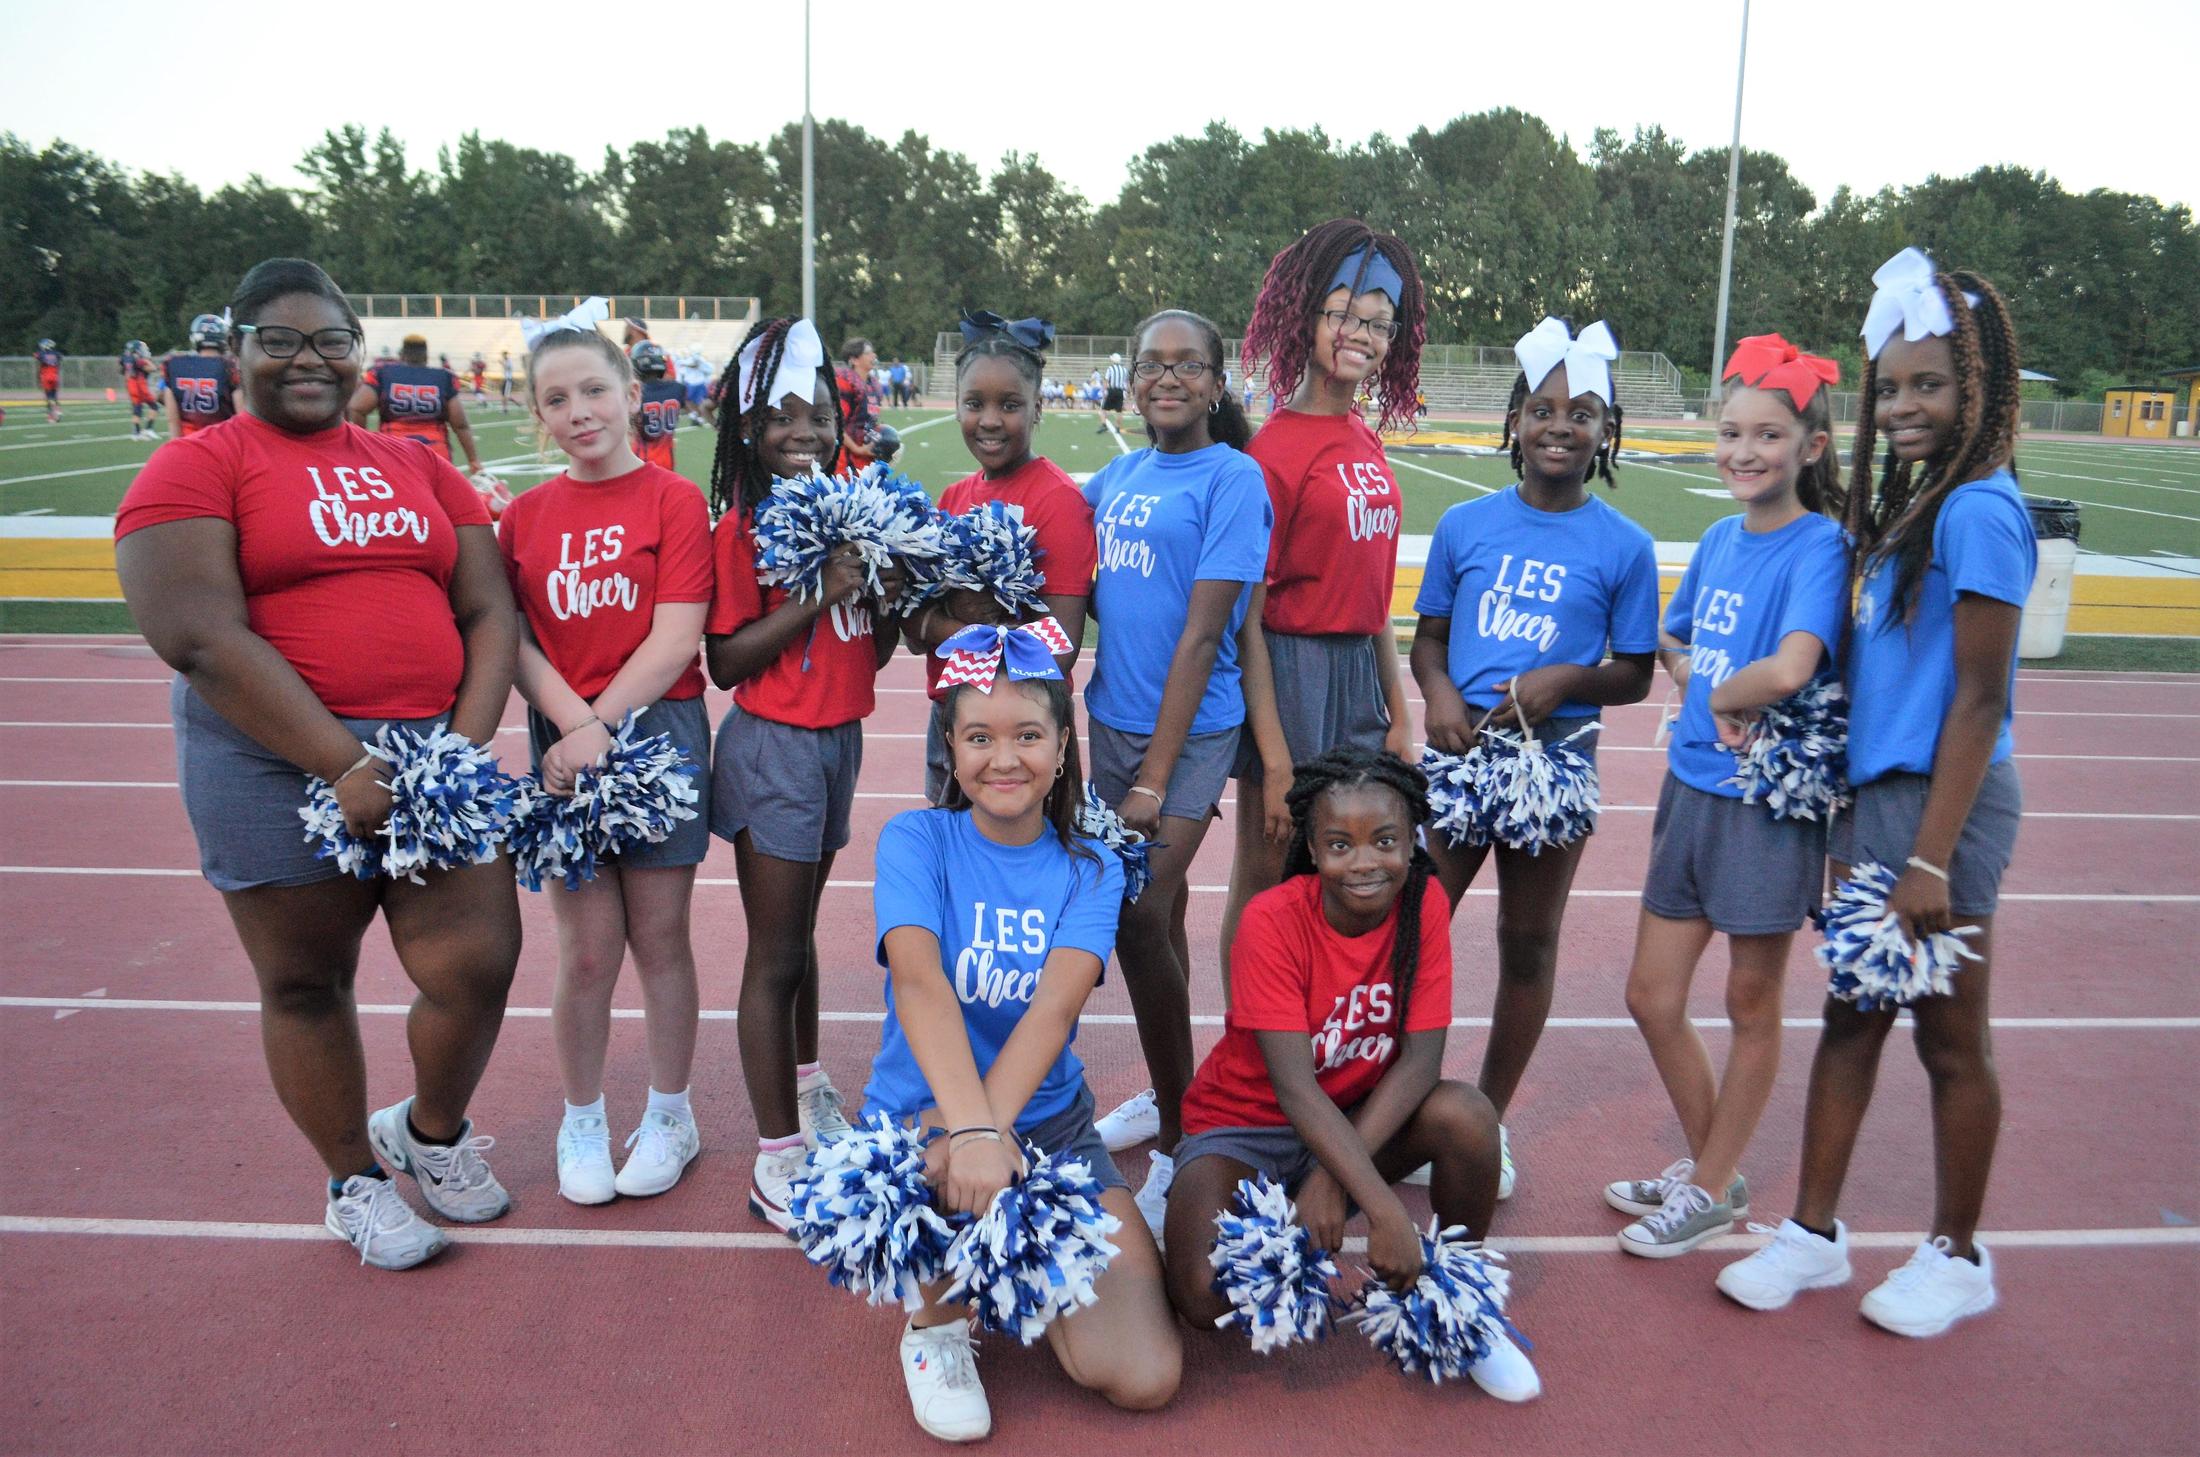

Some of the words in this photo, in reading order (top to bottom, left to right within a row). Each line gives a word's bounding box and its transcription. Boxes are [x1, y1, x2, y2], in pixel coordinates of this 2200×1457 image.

[176, 377, 219, 414] 75
[389, 382, 442, 416] 55
[643, 398, 681, 437] 30
[306, 466, 394, 500] LES
[1336, 462, 1390, 495] LES
[309, 499, 430, 547] Cheer
[1103, 491, 1161, 528] LES
[1346, 494, 1399, 542] Cheer
[558, 524, 625, 570] LES
[1096, 522, 1156, 578] Cheer
[546, 569, 639, 620] Cheer
[1493, 554, 1567, 603] LES
[1478, 590, 1560, 653] Cheer
[1692, 585, 1743, 636] LES
[1010, 666, 1056, 678] ALYSSA
[971, 902, 1046, 955] LES
[1322, 982, 1393, 1031] LES
[1310, 1028, 1395, 1074] Cheer
